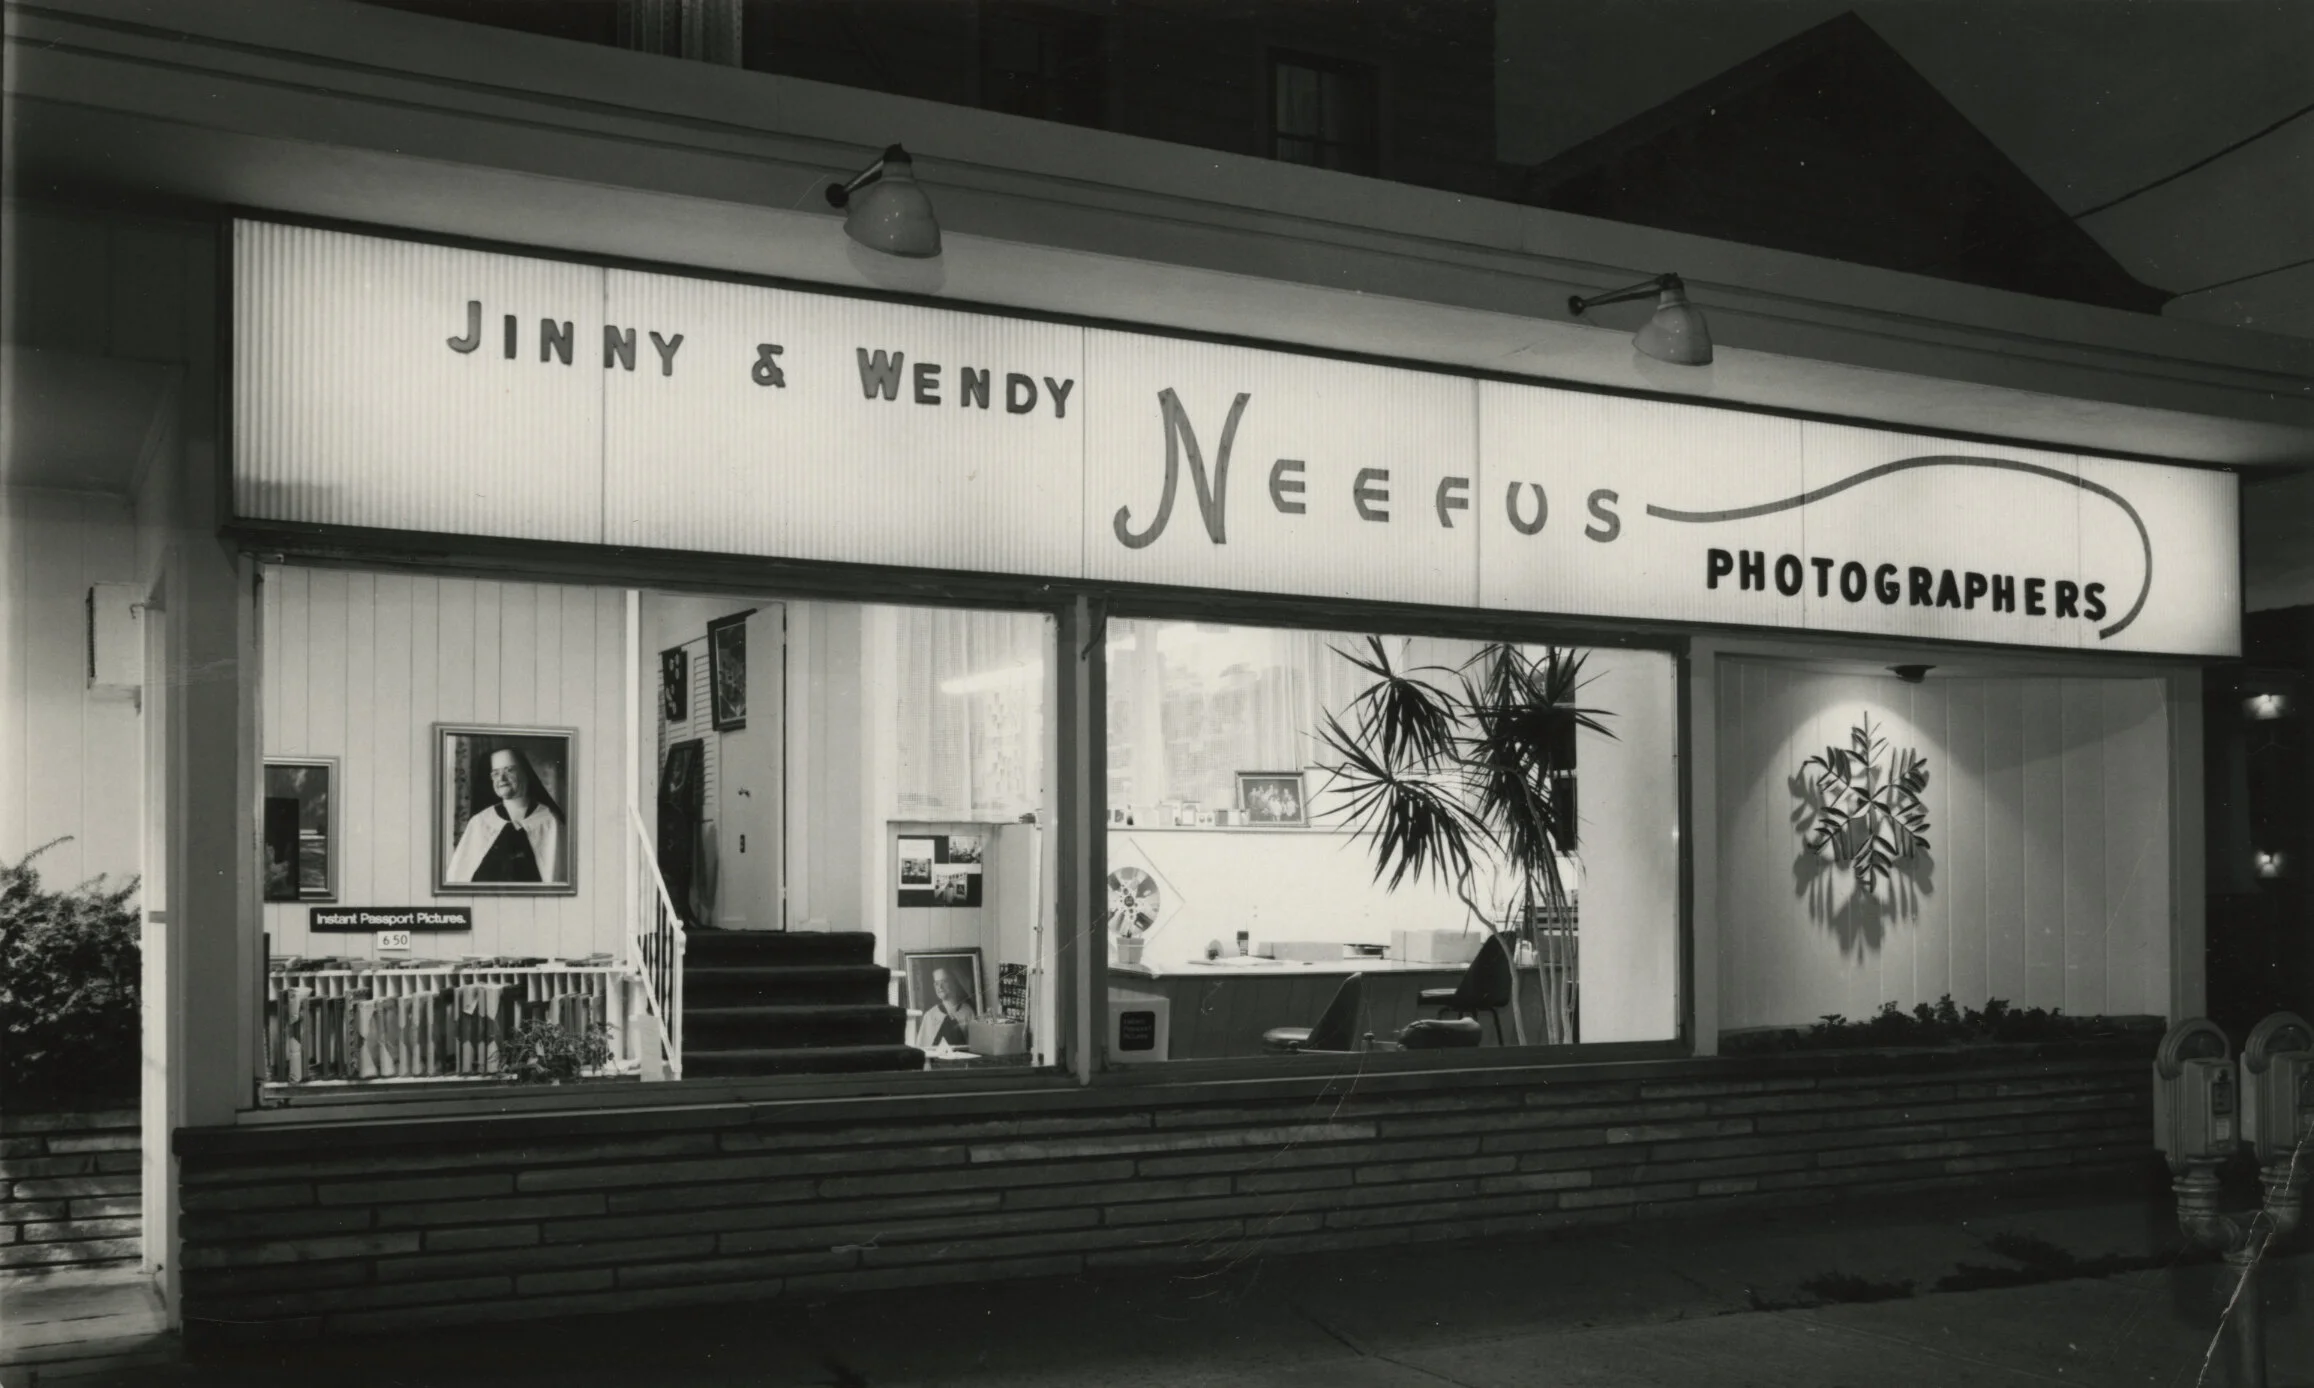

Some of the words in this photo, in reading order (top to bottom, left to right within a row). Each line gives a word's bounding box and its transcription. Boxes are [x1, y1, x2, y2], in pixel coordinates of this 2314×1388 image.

[446, 300, 684, 376] JINNY
[751, 343, 786, 388] &
[856, 347, 1074, 418] WENDY
[1113, 387, 1622, 549] NEEFUS
[1706, 548, 2107, 622] PHOTOGRAPHERS
[317, 913, 358, 925] Instant
[360, 912, 415, 926] Passport
